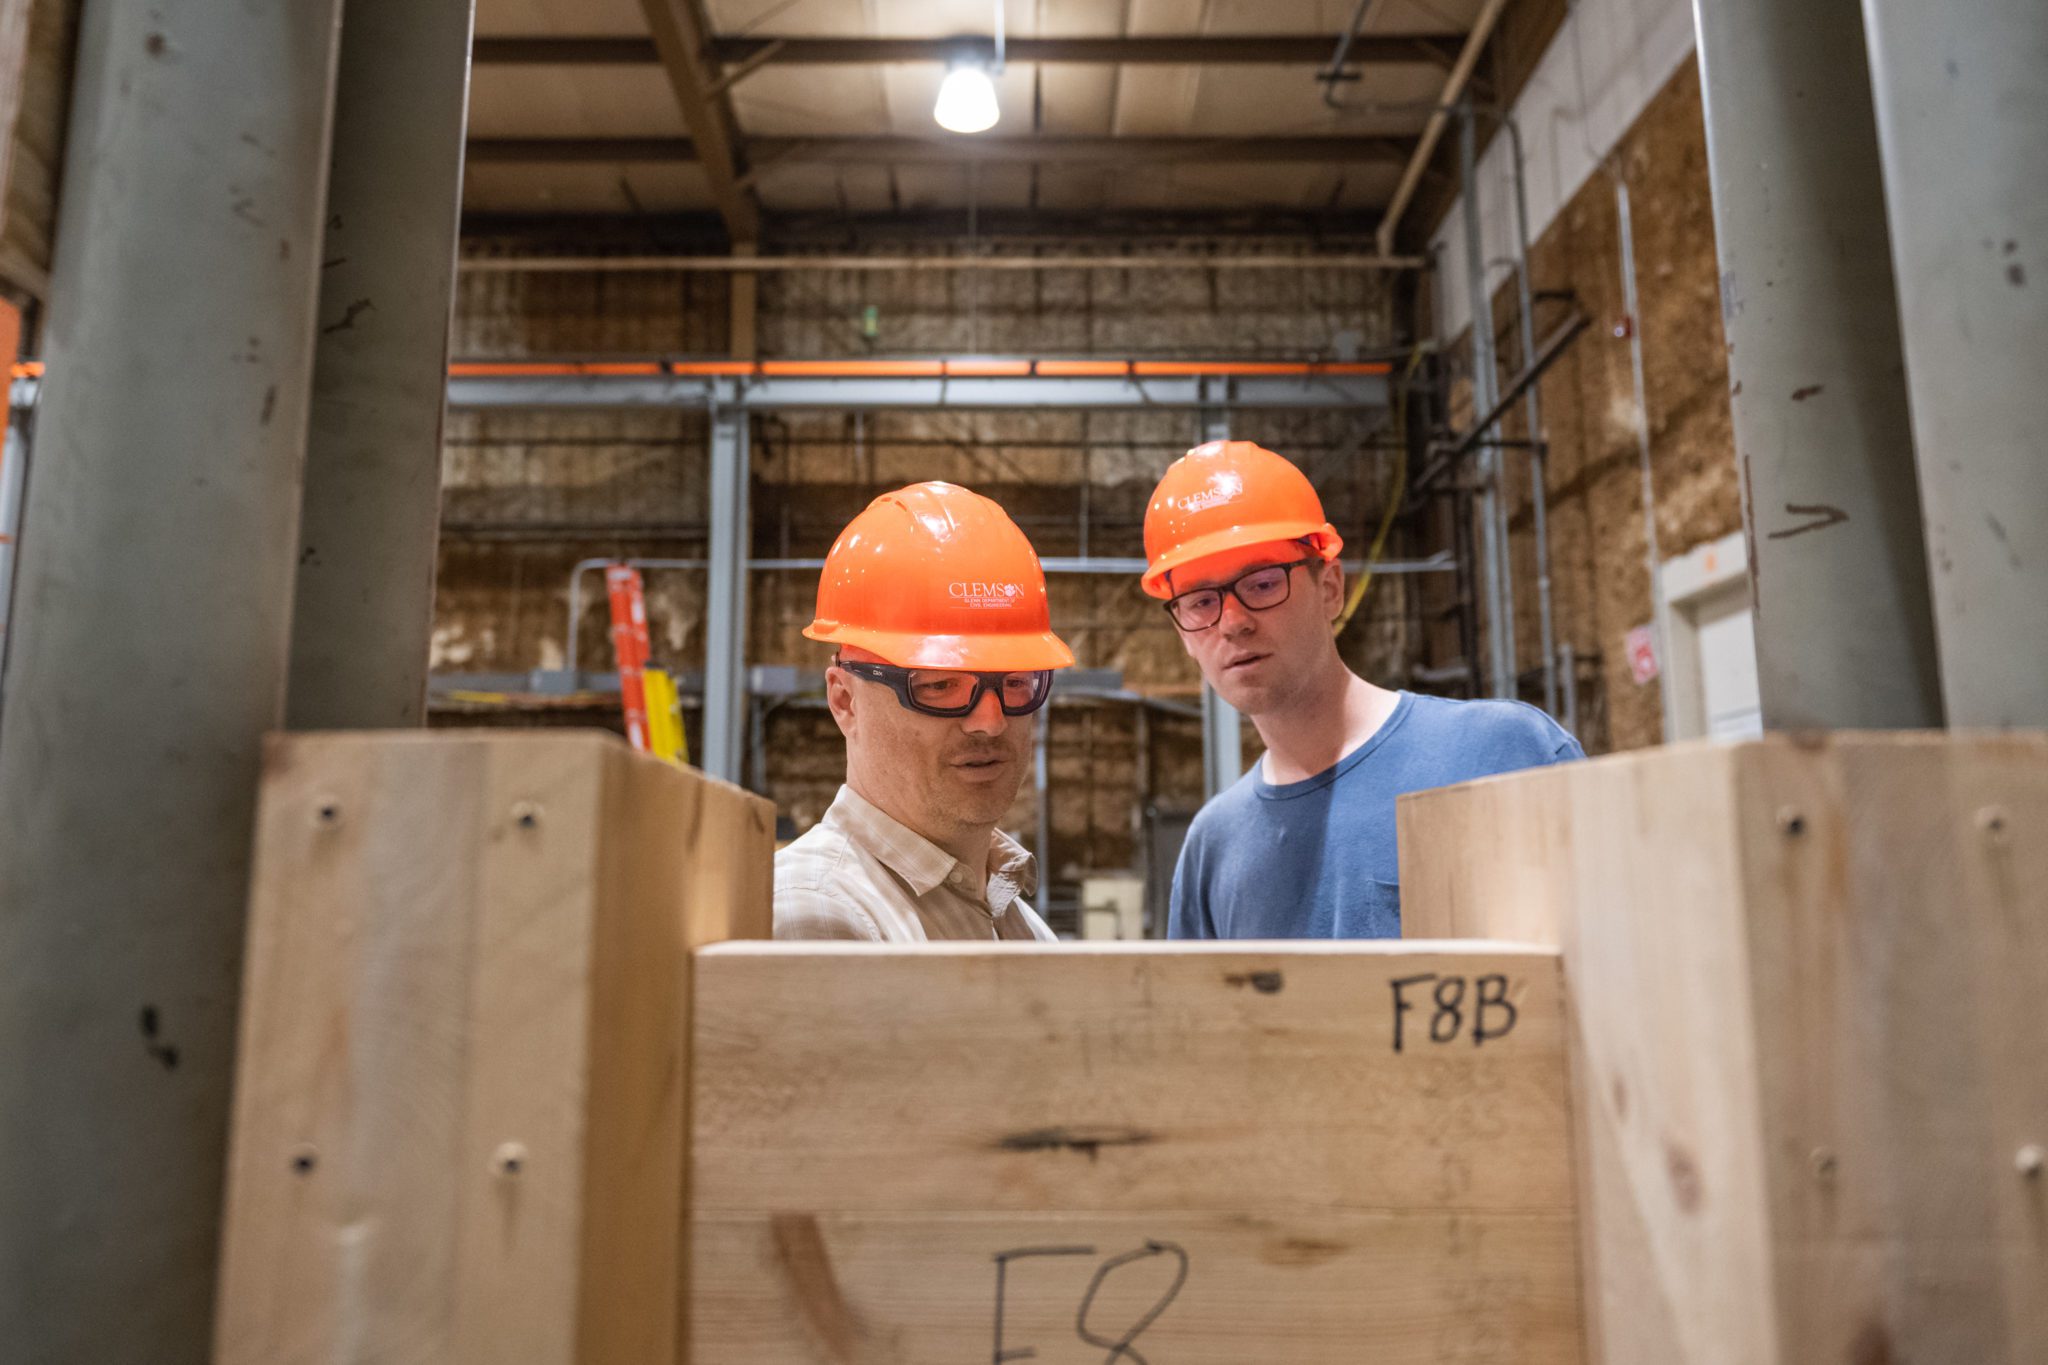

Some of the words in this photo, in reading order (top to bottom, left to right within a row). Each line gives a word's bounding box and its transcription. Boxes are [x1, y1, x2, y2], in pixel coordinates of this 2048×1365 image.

[1177, 481, 1243, 509] CLEMSN
[1390, 973, 1517, 1052] F8B
[993, 1238, 1188, 1365] F8
